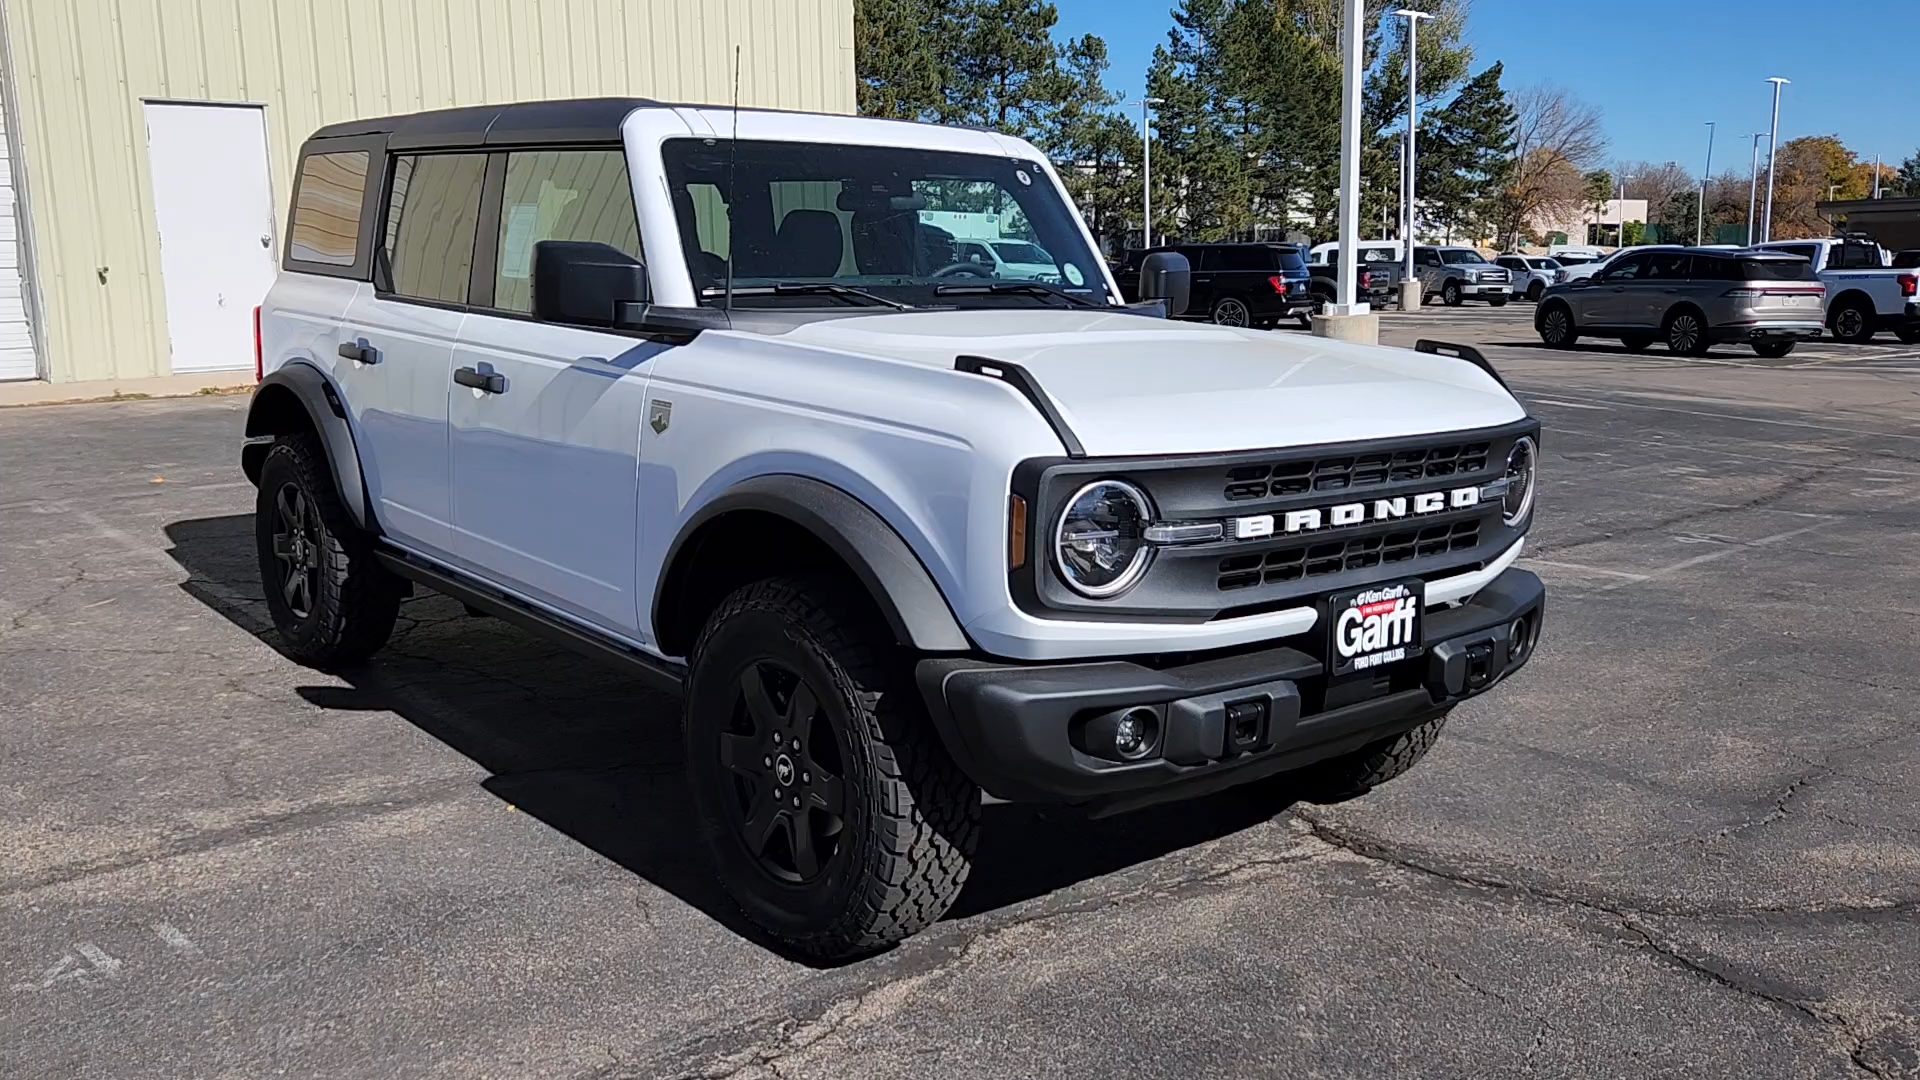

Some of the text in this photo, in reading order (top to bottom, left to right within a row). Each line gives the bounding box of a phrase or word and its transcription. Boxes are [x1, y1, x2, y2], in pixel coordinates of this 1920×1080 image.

[1235, 487, 1479, 538] BRONCO
[1365, 590, 1382, 604] Ken
[1382, 584, 1404, 600] Garff
[1336, 596, 1416, 657] Garff
[1383, 647, 1405, 663] COLLINS
